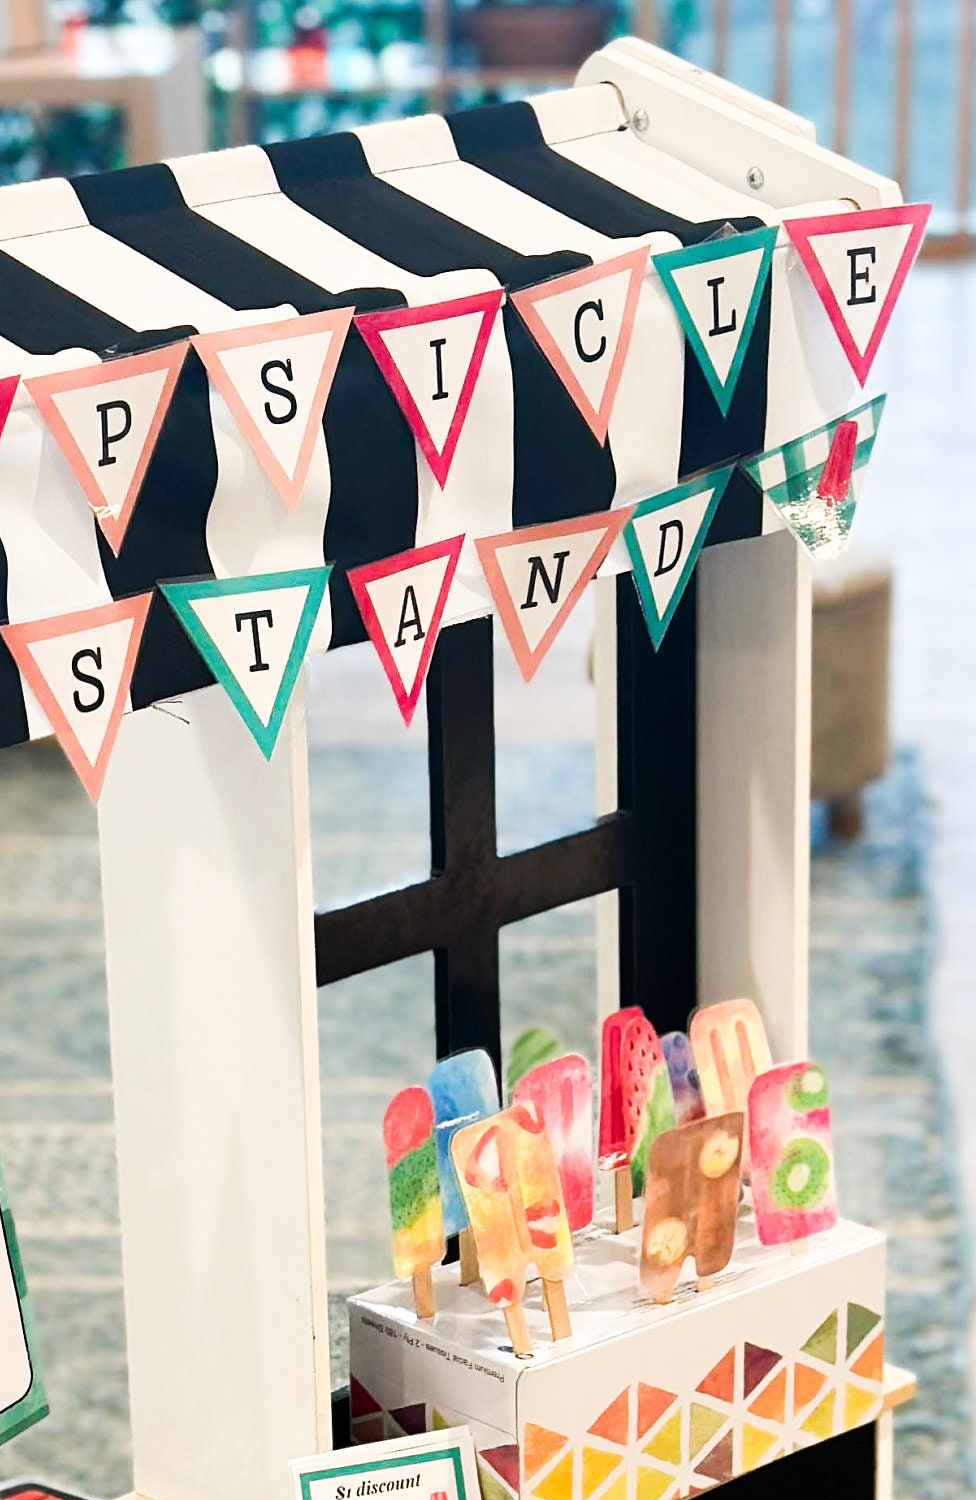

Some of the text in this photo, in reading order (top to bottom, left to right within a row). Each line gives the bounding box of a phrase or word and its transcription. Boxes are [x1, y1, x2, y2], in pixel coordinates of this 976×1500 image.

[70, 518, 685, 713] STAND
[403, 1331, 415, 1346] Ply
[415, 1339, 420, 1348] 2
[356, 1473, 421, 1497] discount
